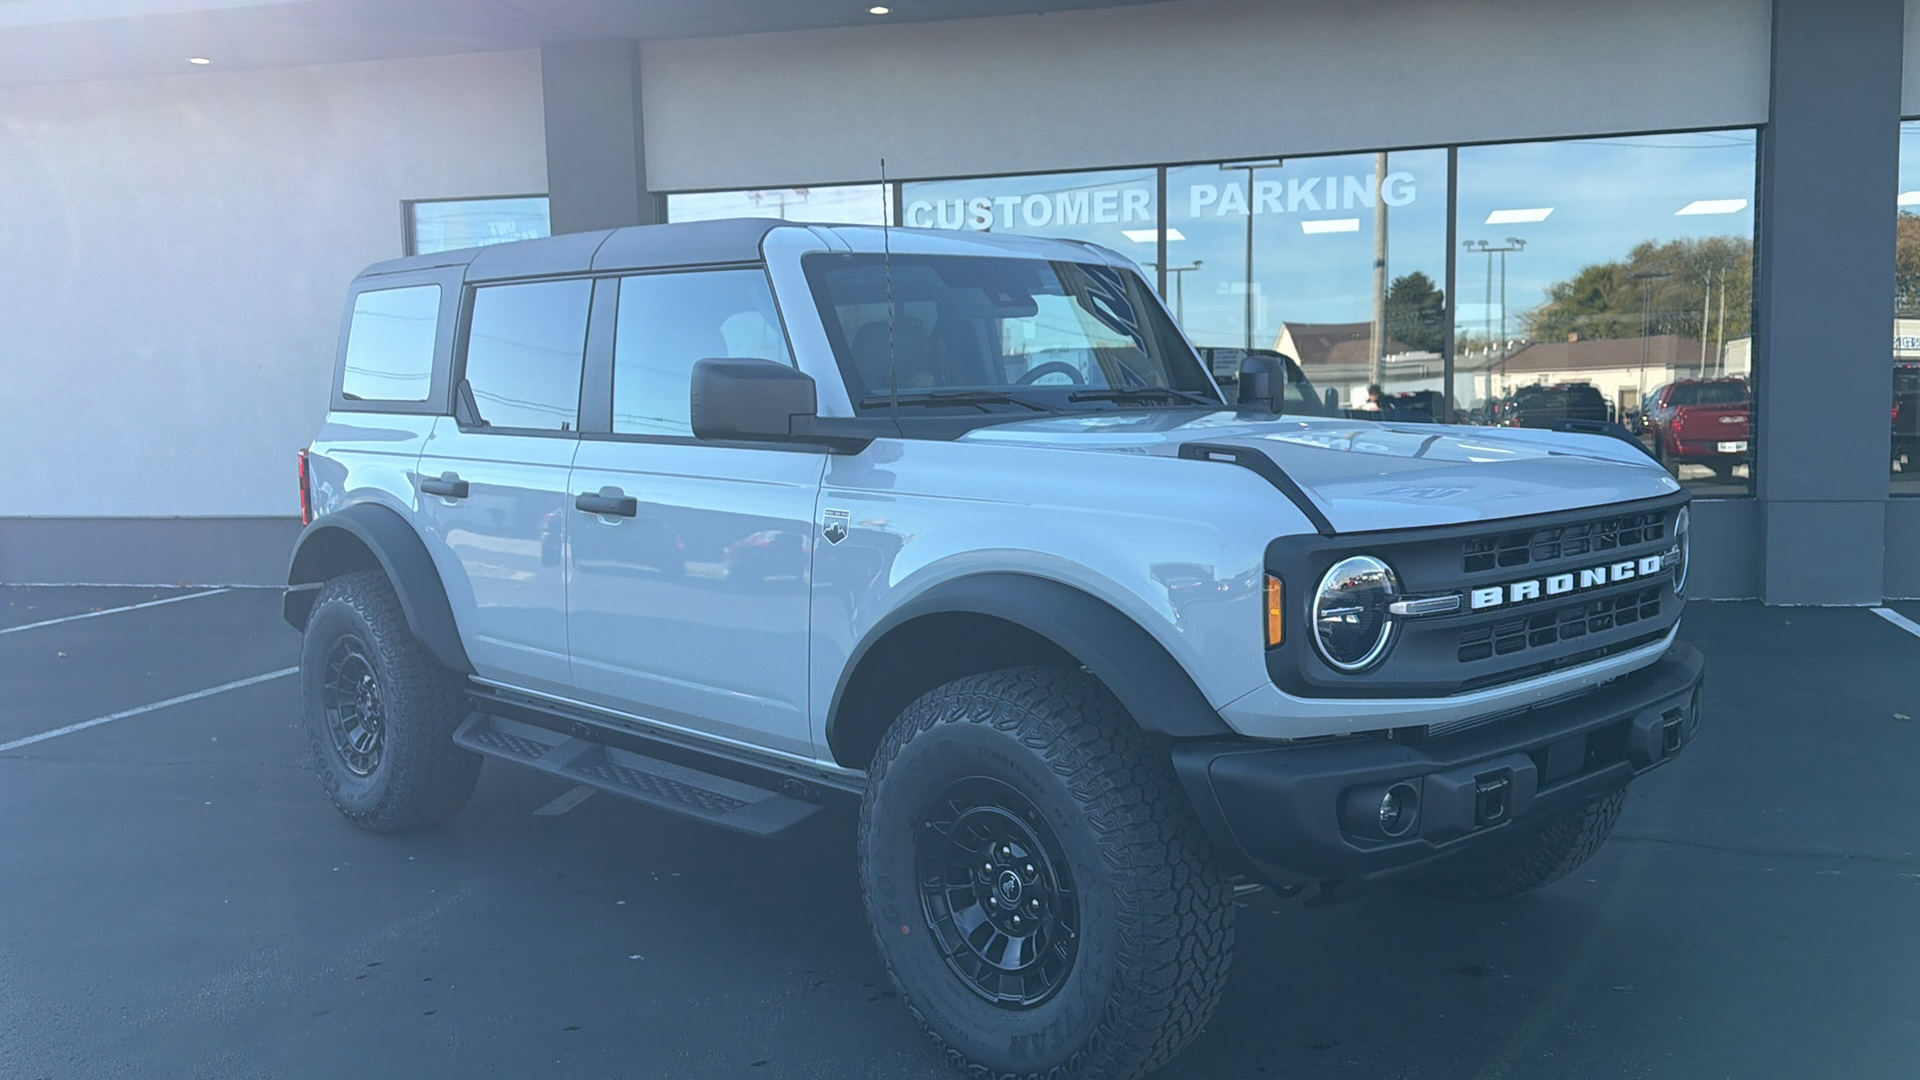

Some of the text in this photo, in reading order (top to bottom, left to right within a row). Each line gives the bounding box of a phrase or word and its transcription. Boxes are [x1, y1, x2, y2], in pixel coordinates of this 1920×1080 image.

[906, 171, 1417, 231] CUSTOMER PARKING
[1471, 555, 1661, 609] BRONCO
